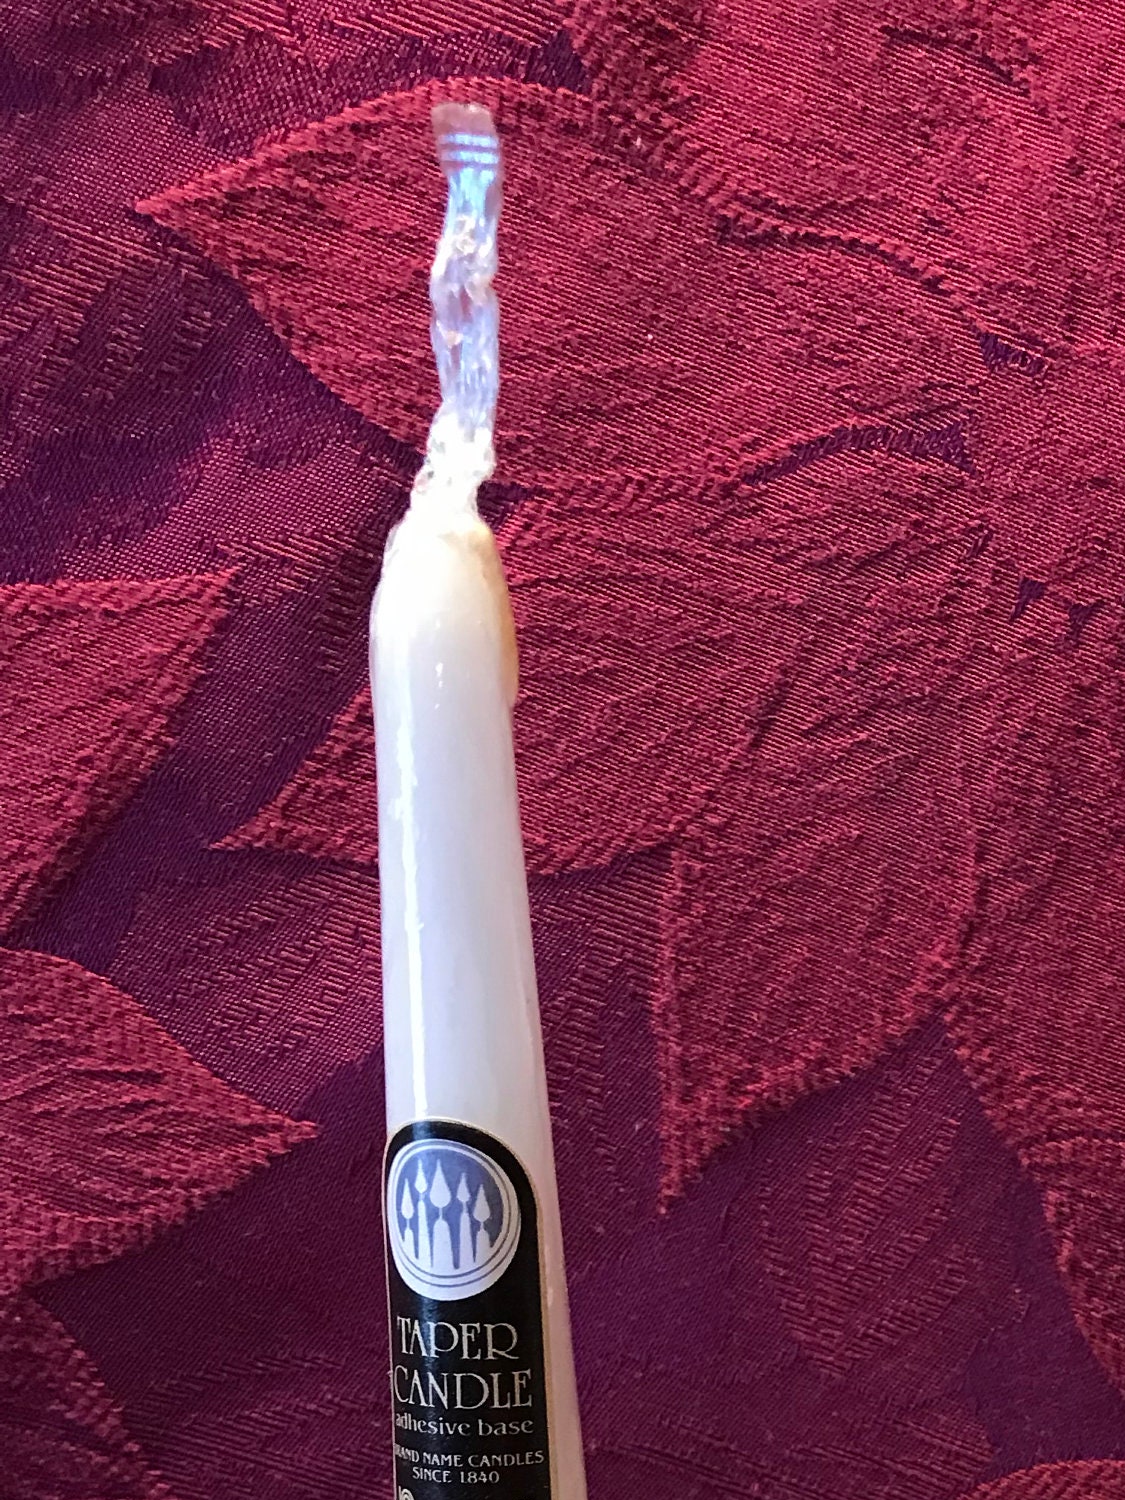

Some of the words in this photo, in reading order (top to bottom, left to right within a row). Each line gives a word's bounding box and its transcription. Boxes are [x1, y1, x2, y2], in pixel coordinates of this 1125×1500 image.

[396, 1316, 520, 1361] TAPER
[393, 1365, 533, 1410] CANDLE
[395, 1412, 471, 1436] adhesive
[478, 1418, 534, 1436] base
[422, 1451, 464, 1468] NAME
[467, 1450, 546, 1468] CANDLES
[412, 1466, 452, 1484] SINCE
[459, 1470, 501, 1484] 1840
